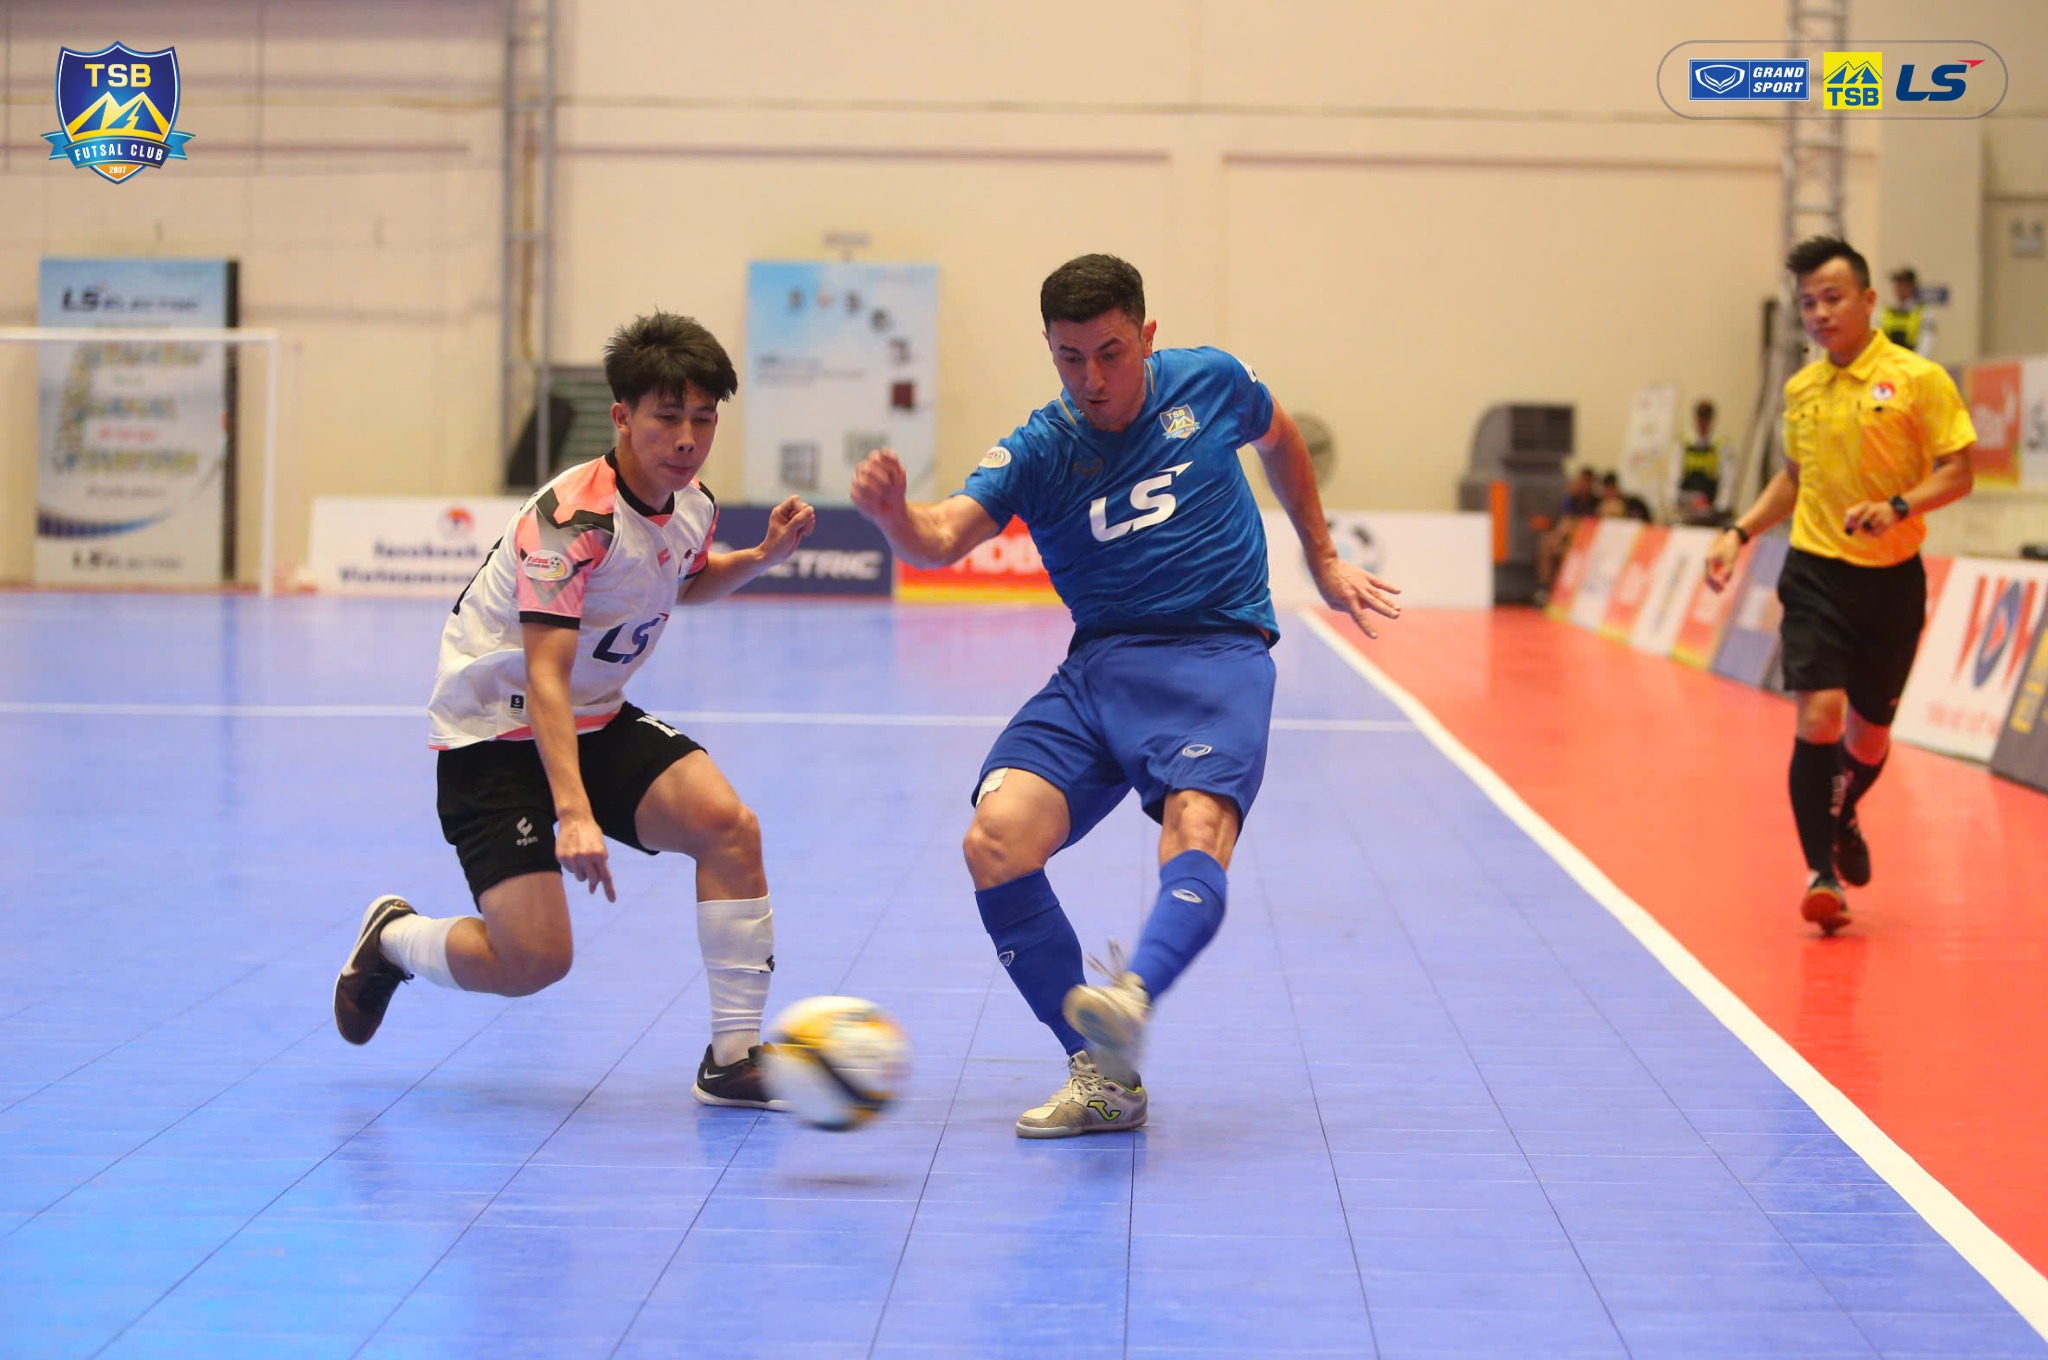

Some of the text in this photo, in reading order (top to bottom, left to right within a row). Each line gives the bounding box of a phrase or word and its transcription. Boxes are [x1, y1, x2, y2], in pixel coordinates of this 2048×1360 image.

[1166, 409, 1186, 420] TSB
[1089, 473, 1177, 542] LS
[592, 617, 660, 664] LS
